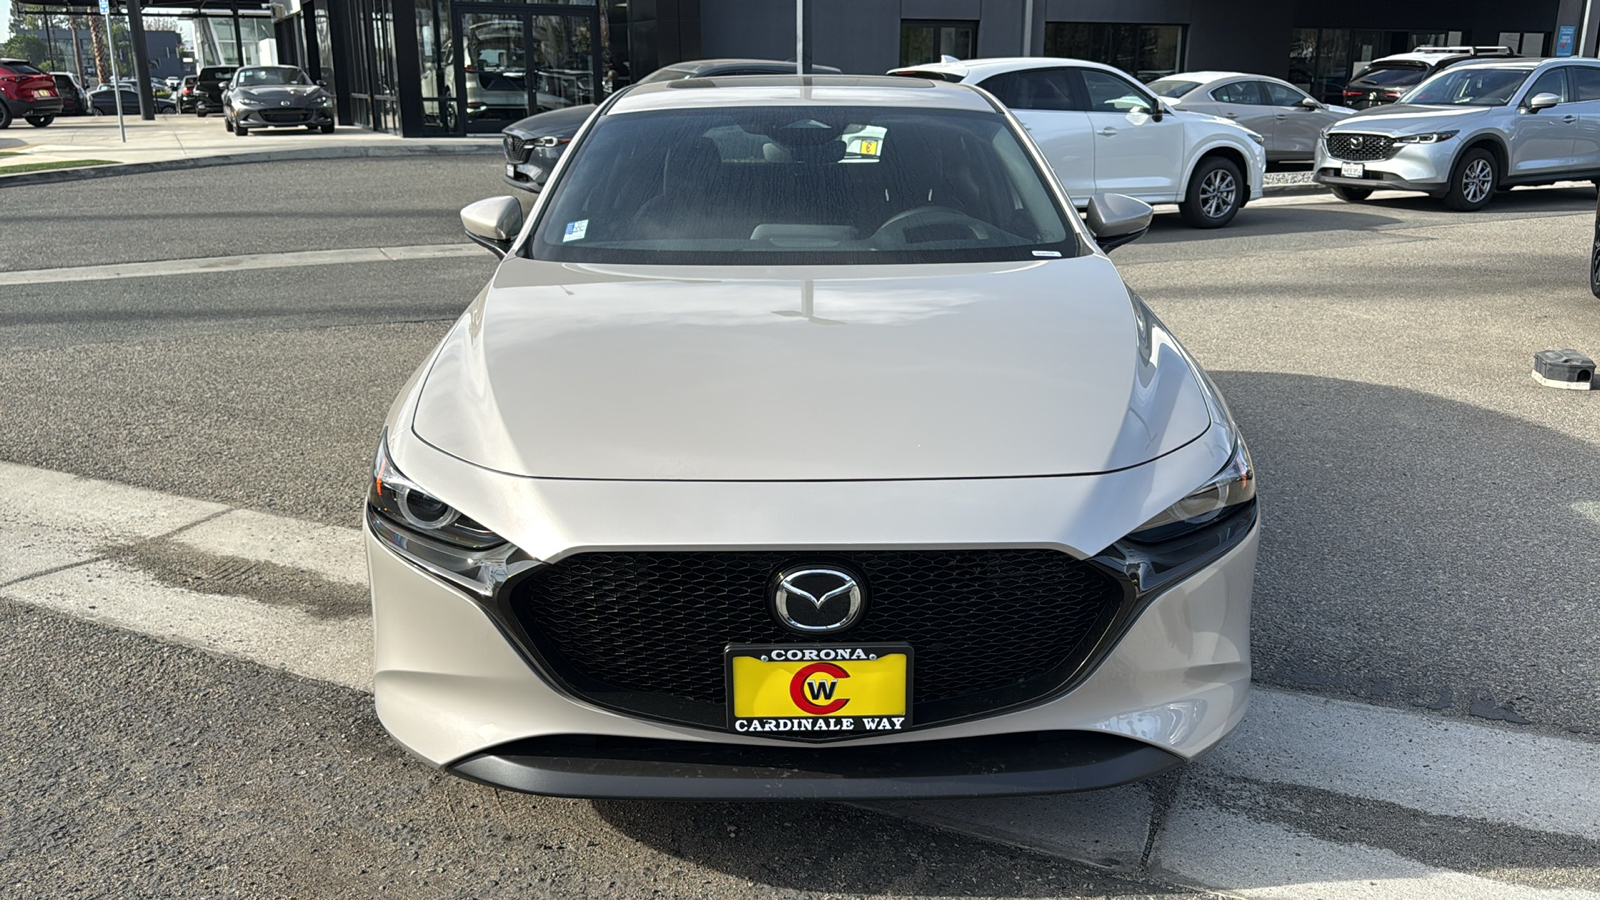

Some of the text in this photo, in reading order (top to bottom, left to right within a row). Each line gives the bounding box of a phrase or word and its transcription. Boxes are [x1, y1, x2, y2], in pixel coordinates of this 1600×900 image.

[771, 648, 867, 661] CORONA
[789, 662, 851, 715] C
[807, 679, 838, 701] W
[735, 717, 905, 732] CARDINALE WAY
